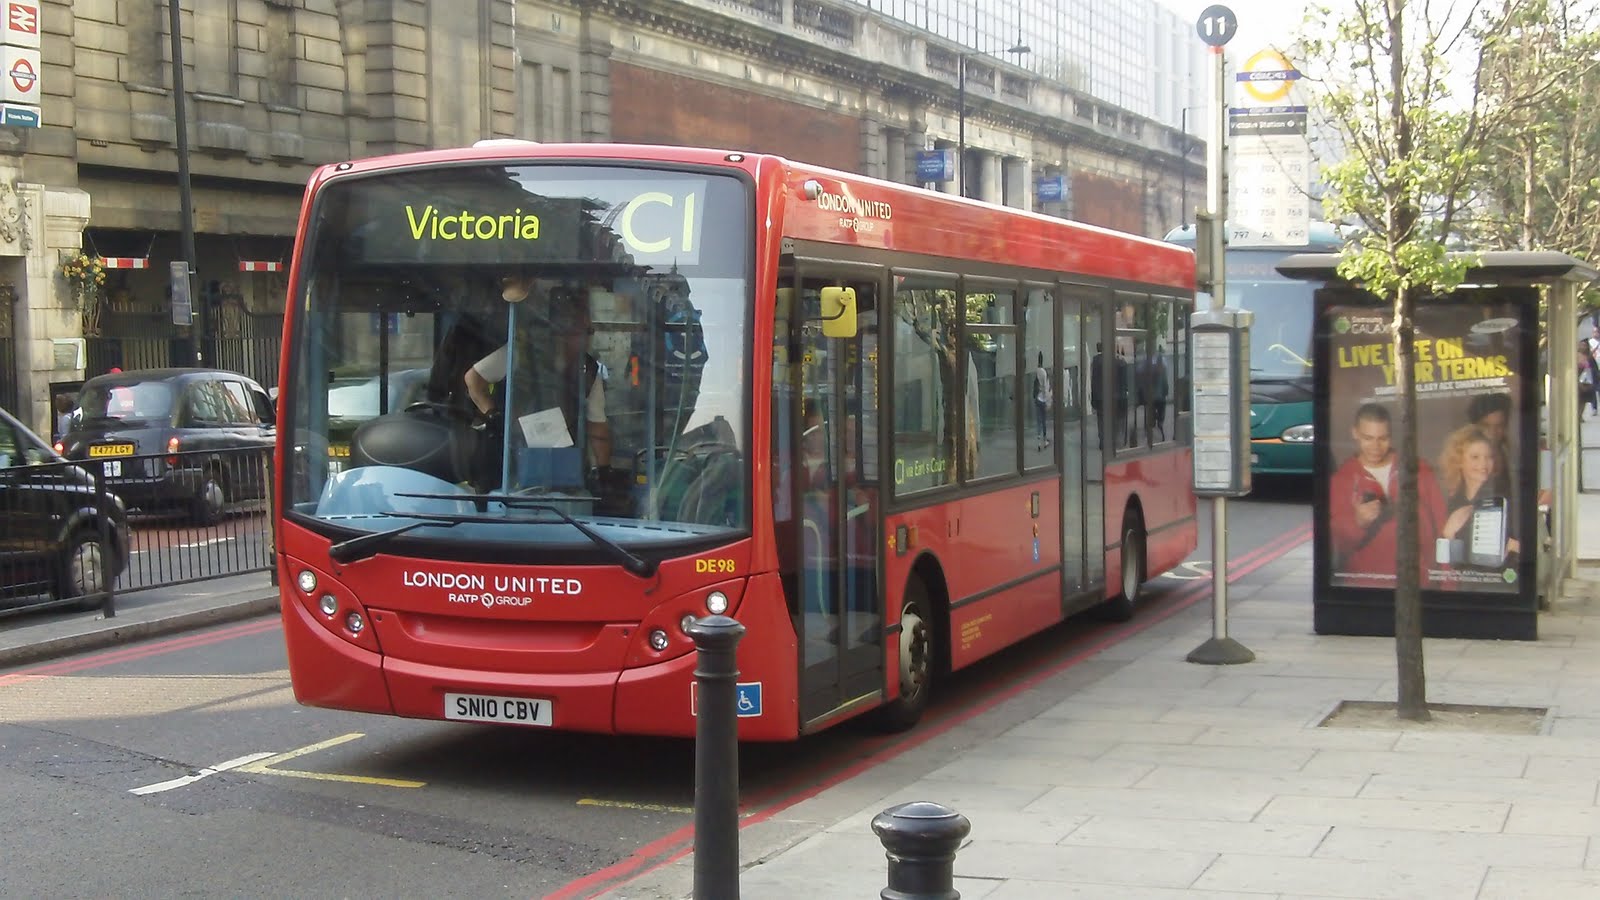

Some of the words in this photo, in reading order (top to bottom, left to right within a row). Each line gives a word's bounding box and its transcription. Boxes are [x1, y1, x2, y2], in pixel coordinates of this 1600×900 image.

[1203, 16, 1227, 37] 11
[817, 192, 855, 214] LONDON
[857, 198, 892, 220] UNITED
[405, 205, 540, 240] Victoria
[1338, 344, 1383, 368] LIVE
[1435, 337, 1464, 361] ON
[1437, 355, 1515, 382] TERMS.
[695, 558, 735, 573] DE98
[403, 571, 485, 590] LONDON
[495, 576, 582, 595] UNITED
[448, 593, 479, 604] RATP
[495, 595, 533, 606] GROUP
[456, 697, 498, 718] SN10
[503, 700, 540, 721] CBV
